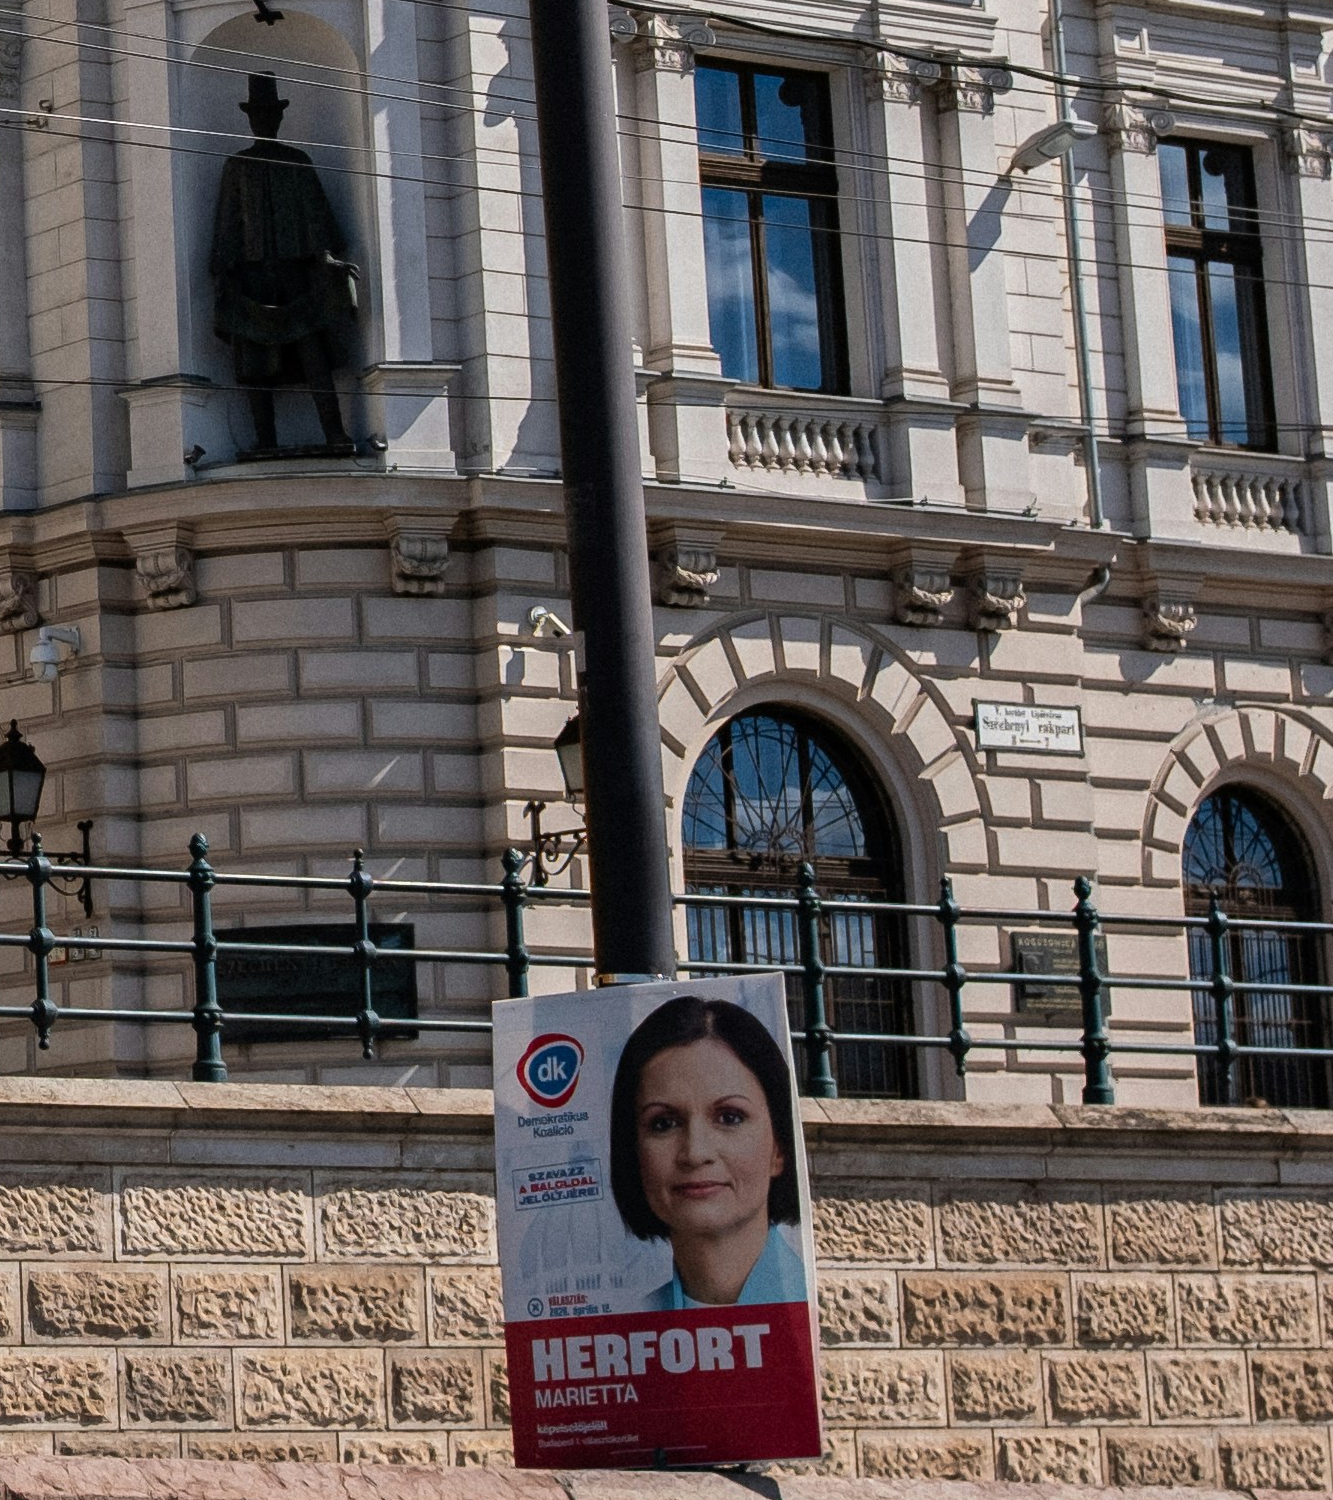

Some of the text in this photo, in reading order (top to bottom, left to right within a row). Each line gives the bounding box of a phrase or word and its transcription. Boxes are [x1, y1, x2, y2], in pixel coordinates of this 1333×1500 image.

[1038, 721, 1075, 738] rakpart
[537, 1056, 568, 1083] dk
[518, 1111, 589, 1128] Demokratikus
[528, 1166, 585, 1182] SZAVAZZ
[519, 1176, 597, 1195] A BALOLDAL
[532, 1324, 770, 1382] HERFORT
[535, 1383, 639, 1409] MARIETTA
